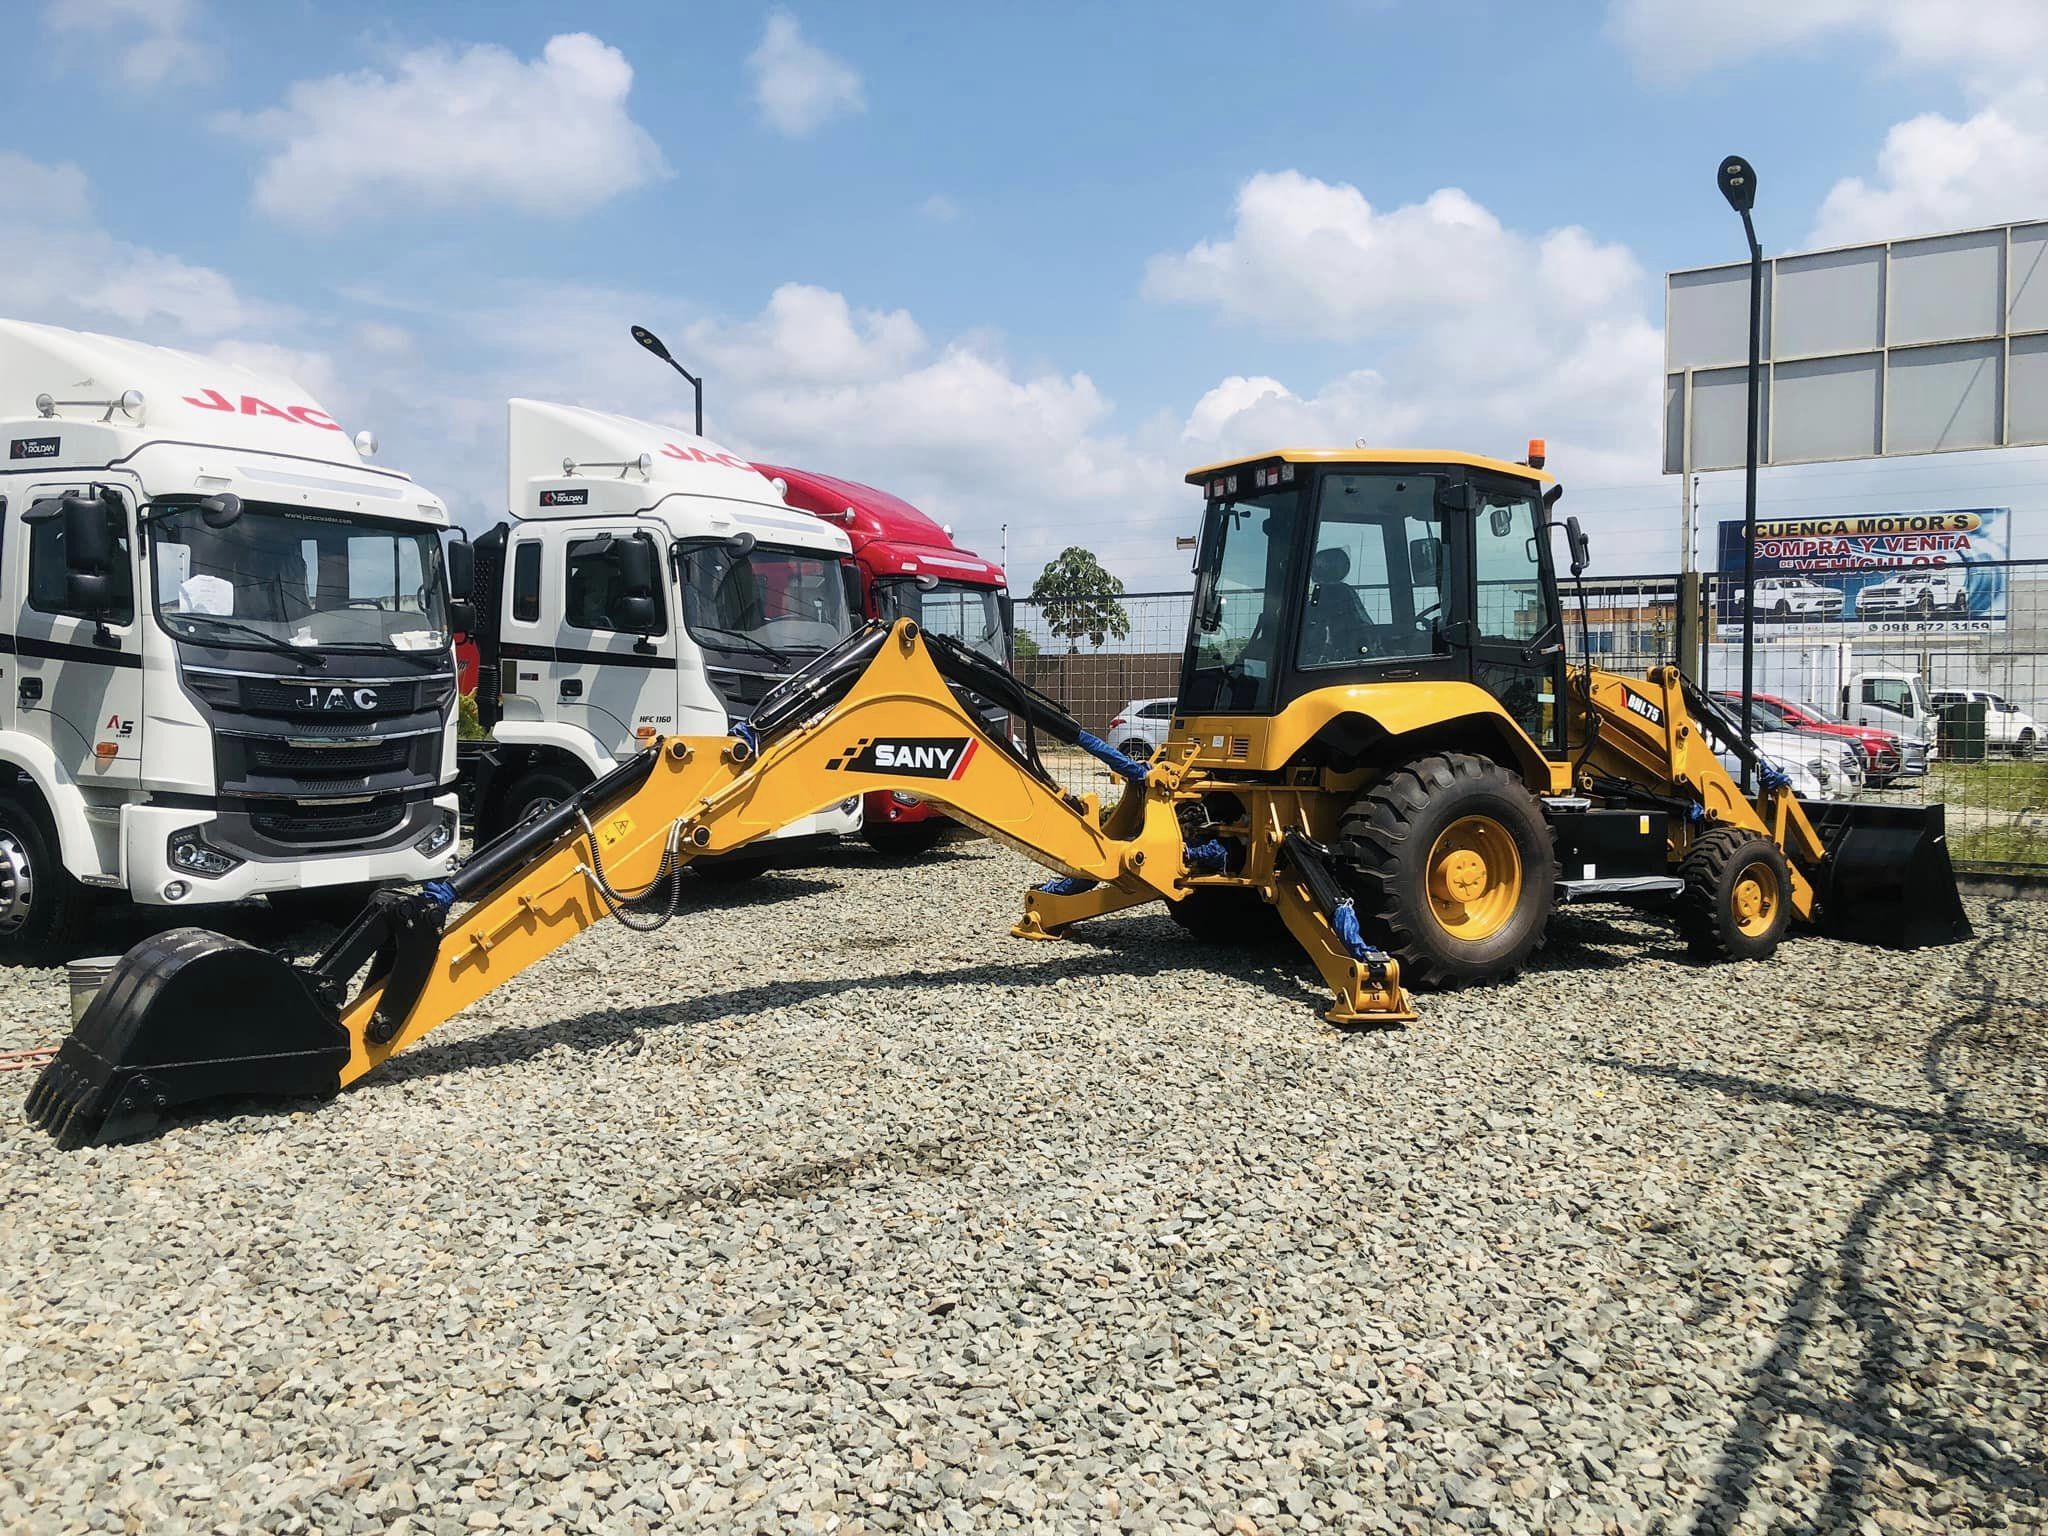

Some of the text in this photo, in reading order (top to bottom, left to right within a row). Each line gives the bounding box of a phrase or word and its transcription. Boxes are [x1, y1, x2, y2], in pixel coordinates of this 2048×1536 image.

[181, 388, 344, 432] JAC
[28, 444, 56, 453] ROLDAN
[659, 442, 756, 472] JAC
[1755, 521, 1849, 537] CUENCA
[1753, 535, 1971, 557] COMPRA Y VENTA
[1780, 560, 1794, 568] DE
[1882, 622, 1990, 632] 098 872 3159
[295, 687, 378, 710] JAC
[639, 715, 672, 723] HFC 1160
[875, 744, 955, 769] SANY
